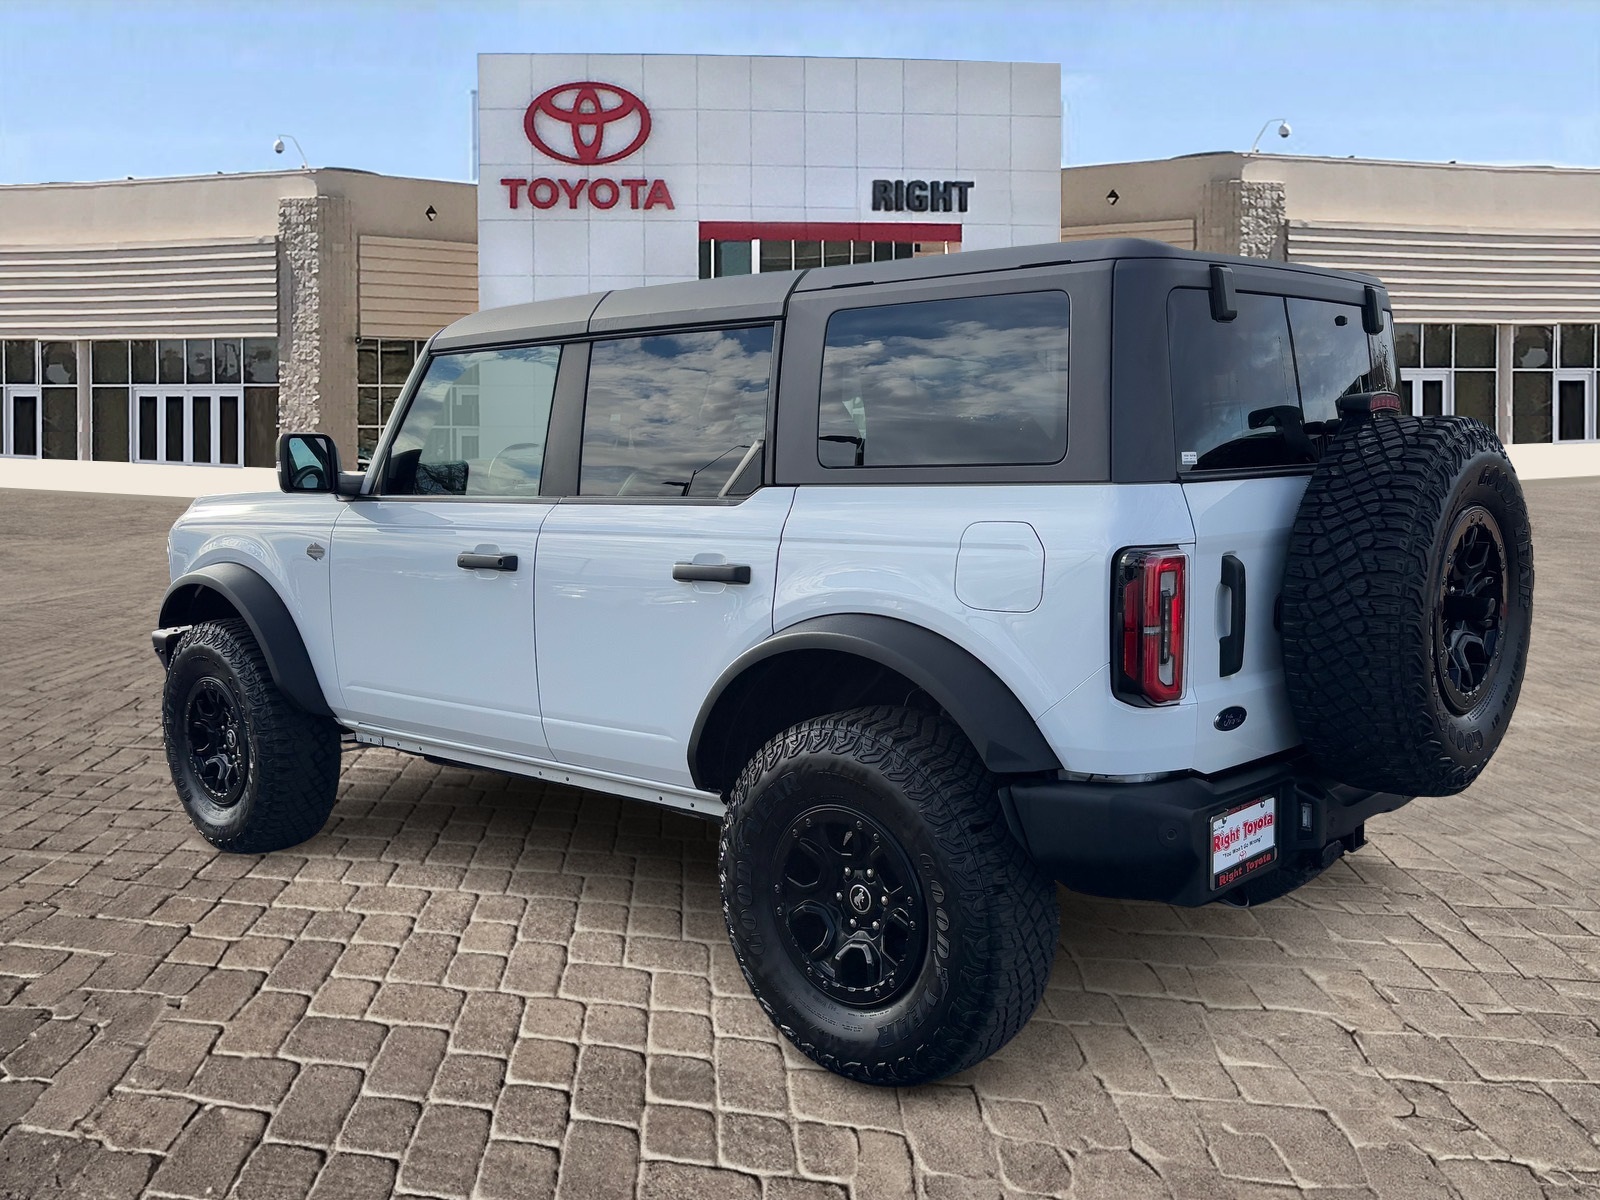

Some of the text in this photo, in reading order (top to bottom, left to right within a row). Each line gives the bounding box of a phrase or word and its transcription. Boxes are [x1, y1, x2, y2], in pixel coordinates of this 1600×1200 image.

[500, 178, 675, 210] TOYOTA
[872, 179, 975, 212] RIGHT
[1213, 812, 1274, 854] Right Toyota
[1219, 853, 1272, 886] Right Toyota
